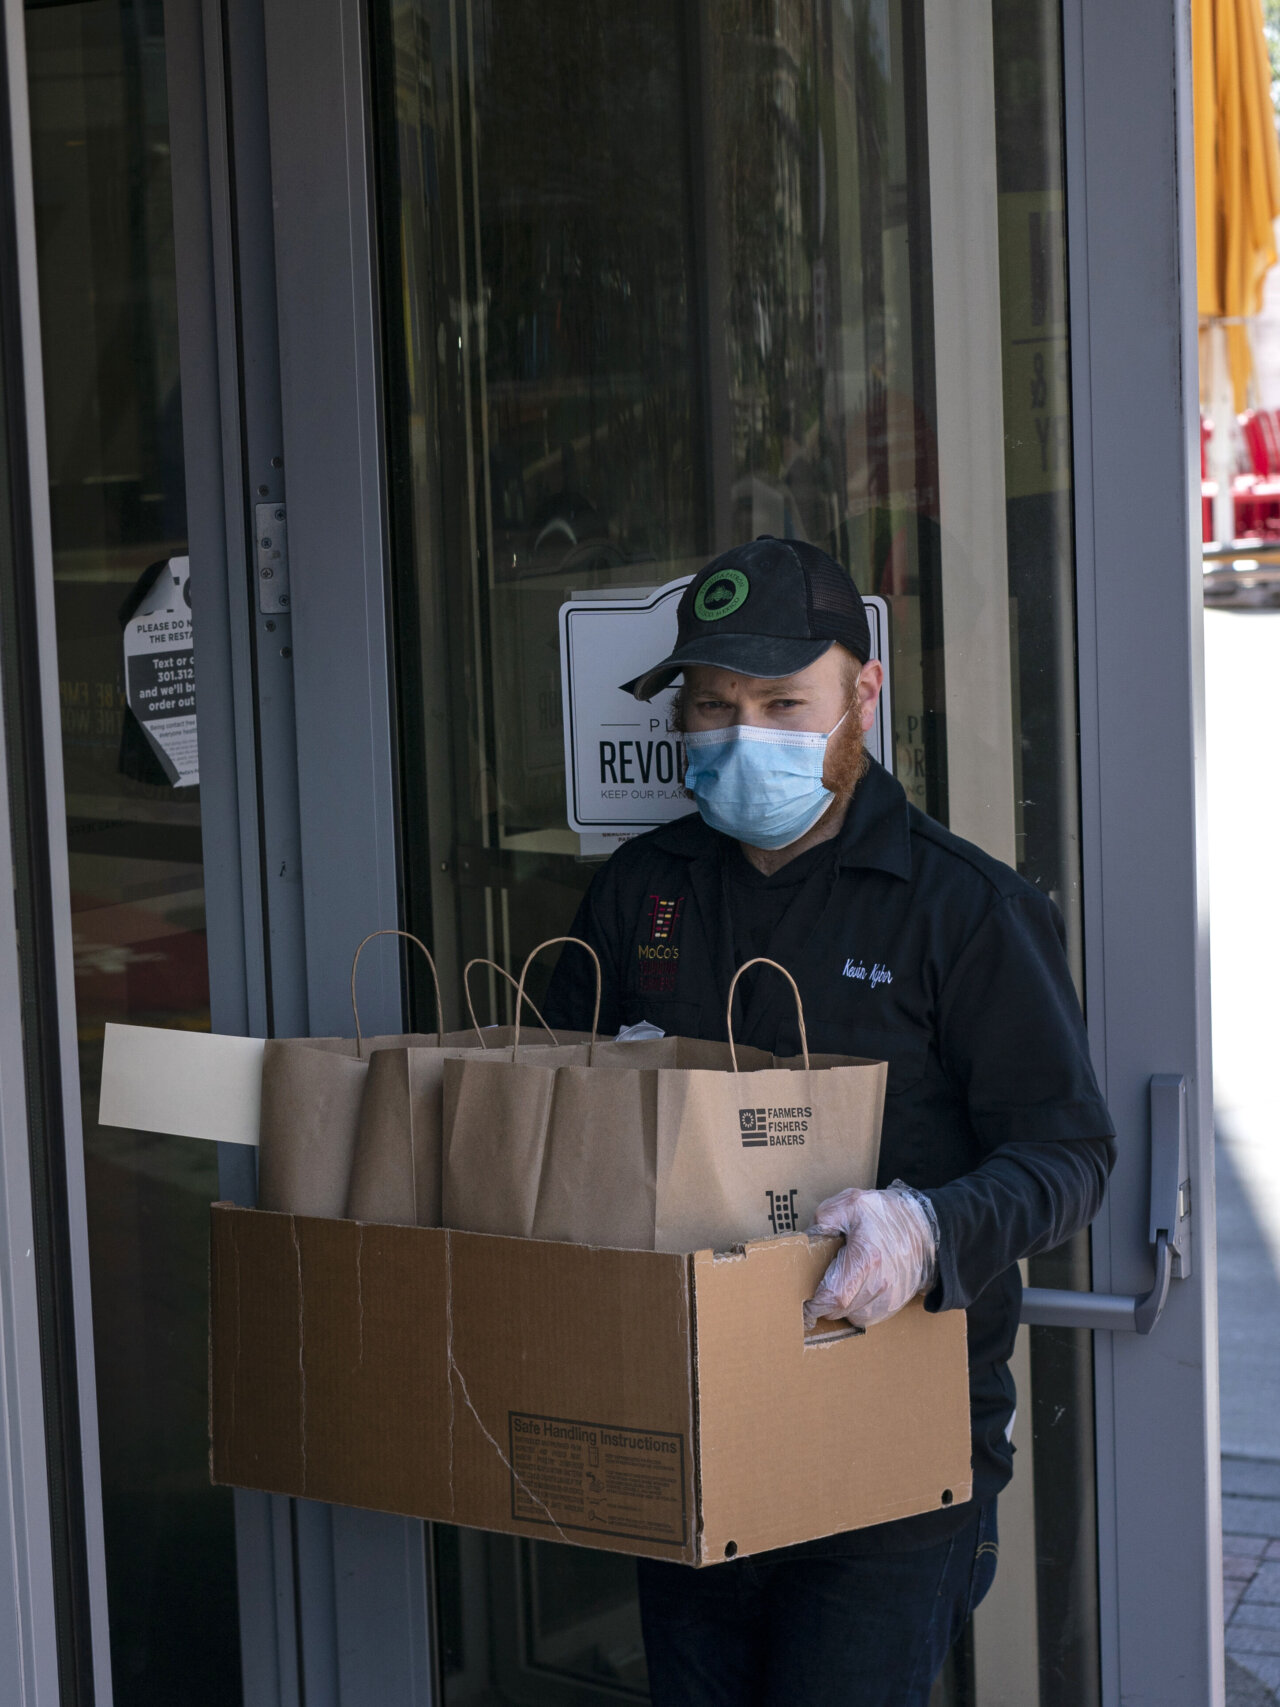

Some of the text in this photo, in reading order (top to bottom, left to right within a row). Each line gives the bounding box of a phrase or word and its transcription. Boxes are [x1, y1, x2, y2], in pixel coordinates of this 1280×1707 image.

[137, 622, 169, 634] PLEASE
[172, 620, 184, 630] DO
[149, 634, 166, 644] THE
[152, 657, 174, 669] Text
[176, 657, 187, 666] or
[139, 685, 158, 699] and
[160, 683, 183, 696] we'll
[148, 696, 195, 711] order out
[600, 789, 629, 799] KEEP
[631, 789, 655, 799] OUR
[638, 944, 679, 960] MoCo's
[767, 1106, 813, 1119] FARMERS
[768, 1120, 809, 1132] FISHERS
[770, 1134, 805, 1146] BAKERS
[513, 1418, 677, 1454] Safe Handling Instructions
